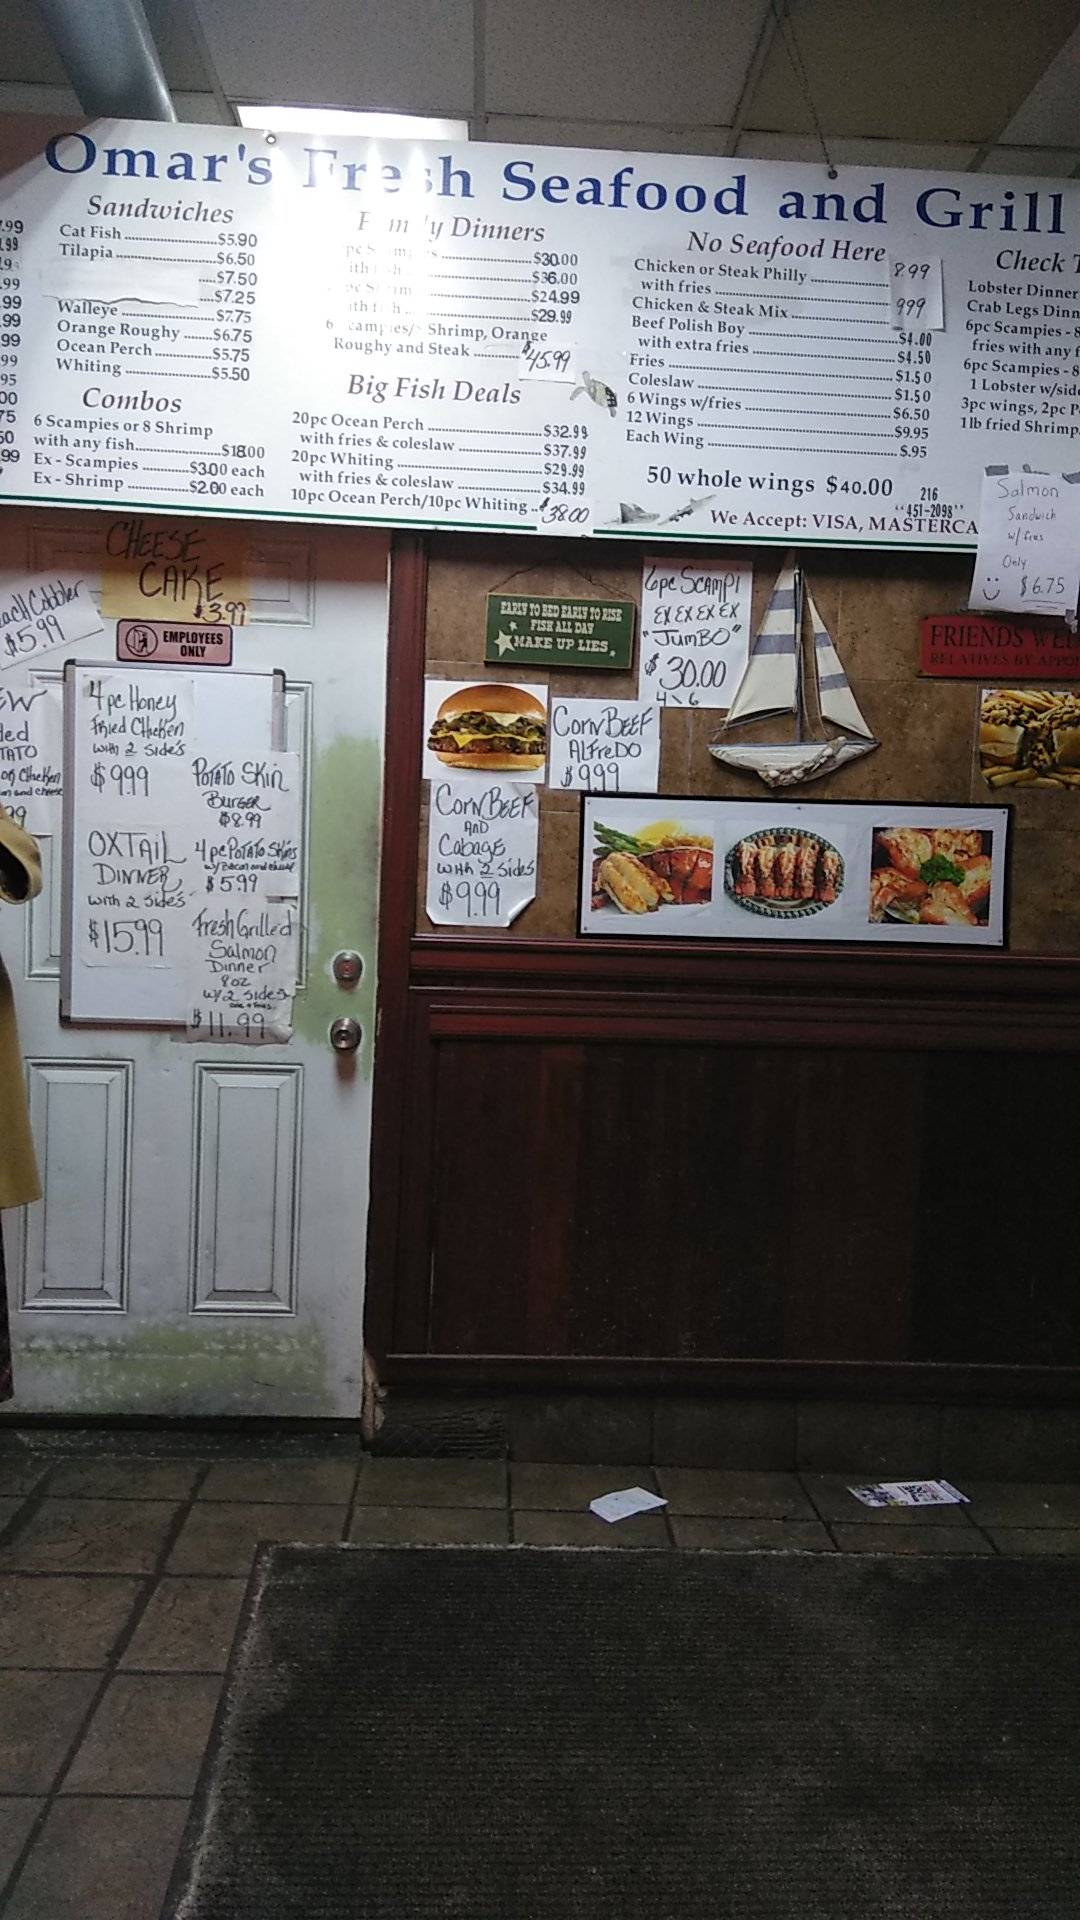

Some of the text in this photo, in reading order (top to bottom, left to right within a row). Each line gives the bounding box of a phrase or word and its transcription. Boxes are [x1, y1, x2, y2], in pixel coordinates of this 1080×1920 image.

[45, 132, 272, 185] Omar's
[502, 160, 748, 216] Seafood
[779, 183, 887, 224] and
[916, 188, 1065, 234] Grill
[87, 195, 234, 223] Sandwiches
[60, 224, 258, 248] Cat Fish $5.90
[450, 216, 545, 242] Dinners
[59, 243, 255, 266] Tilapia $6.50
[687, 231, 886, 262] No Seafood Here
[634, 258, 807, 284] Chicken Steak Philly
[996, 249, 1065, 273] Check
[216, 271, 258, 286] $7.50
[641, 278, 711, 295] with fries
[968, 280, 1022, 297] Lobster
[214, 289, 256, 305] $7.25
[632, 296, 788, 319] Chicken Steak Mix
[57, 300, 251, 323] Walleye $7.75
[967, 299, 1039, 319] Crab Legs
[57, 319, 252, 343] Orange Roughy $6.75
[491, 327, 548, 342] Orange
[631, 316, 745, 337] Beef Polish Boy
[965, 319, 1062, 338] 6pc Scampies
[57, 339, 250, 363] Ocean Perch $5.75
[334, 337, 470, 357] Roughy and Steak
[638, 334, 749, 354] with extra fries
[972, 339, 1042, 355] fries with
[57, 358, 250, 382] Whiting $5.50
[629, 353, 665, 368] Fries
[963, 358, 1060, 377] 6pc Scampies
[348, 374, 521, 403] Big Fish Deals
[628, 372, 931, 404] Coleslaw $1.50
[982, 378, 1036, 394] Lobster
[83, 387, 182, 413] Combos
[638, 392, 930, 421] Wings w/fries $6.50
[989, 400, 1037, 416] wings,
[46, 415, 213, 439] Scampies Shrimp
[291, 411, 424, 431] 20pc Ocean Perch
[645, 411, 929, 440] Wings $9.95
[985, 417, 1020, 432] fried
[34, 434, 101, 453] with any
[300, 432, 455, 451] with fries coleslaw
[626, 430, 704, 449] Each Wing
[65, 454, 265, 479] Scampies each
[291, 450, 394, 471] 20pc Whiting
[65, 474, 264, 498] Shrimp each
[299, 471, 454, 490] with fries coleslaw
[647, 466, 893, 497] 50 whole wings $40.00
[997, 478, 1059, 499] Salmon
[291, 488, 528, 515] 10pc Ocean Perch/10pc Whiting
[920, 487, 938, 501] 216
[710, 509, 863, 532] We Accept: VISA,
[1008, 505, 1056, 521] Sandwich
[105, 519, 206, 562] CHEESE
[1002, 555, 1029, 570] Only
[139, 561, 225, 603] CAKE
[1020, 575, 1065, 597] $6.75
[500, 601, 623, 622] EARLY TO BED EARLY TO RISE
[4, 614, 65, 657] $5.99
[163, 630, 223, 645] EMPLOYEES
[530, 619, 595, 635] FISH ALL DAY
[930, 624, 1024, 649] FRIENDS
[180, 645, 206, 658] ONLY
[513, 635, 609, 652] MAKE UP LIES
[644, 653, 727, 690] $30.00
[129, 684, 177, 722] Honey
[92, 744, 119, 756] with
[90, 762, 150, 797] $9.99
[561, 762, 620, 792] $9.99
[219, 811, 262, 829] $8.99
[480, 862, 494, 878] 2
[206, 873, 258, 893] $5.99
[88, 893, 121, 908] with
[438, 880, 500, 917] $9.99
[236, 908, 292, 938] Grilled
[89, 918, 165, 957] $15.99
[208, 939, 277, 963] Salmon
[205, 959, 274, 974] Dinner
[190, 1008, 265, 1039] $11.99
